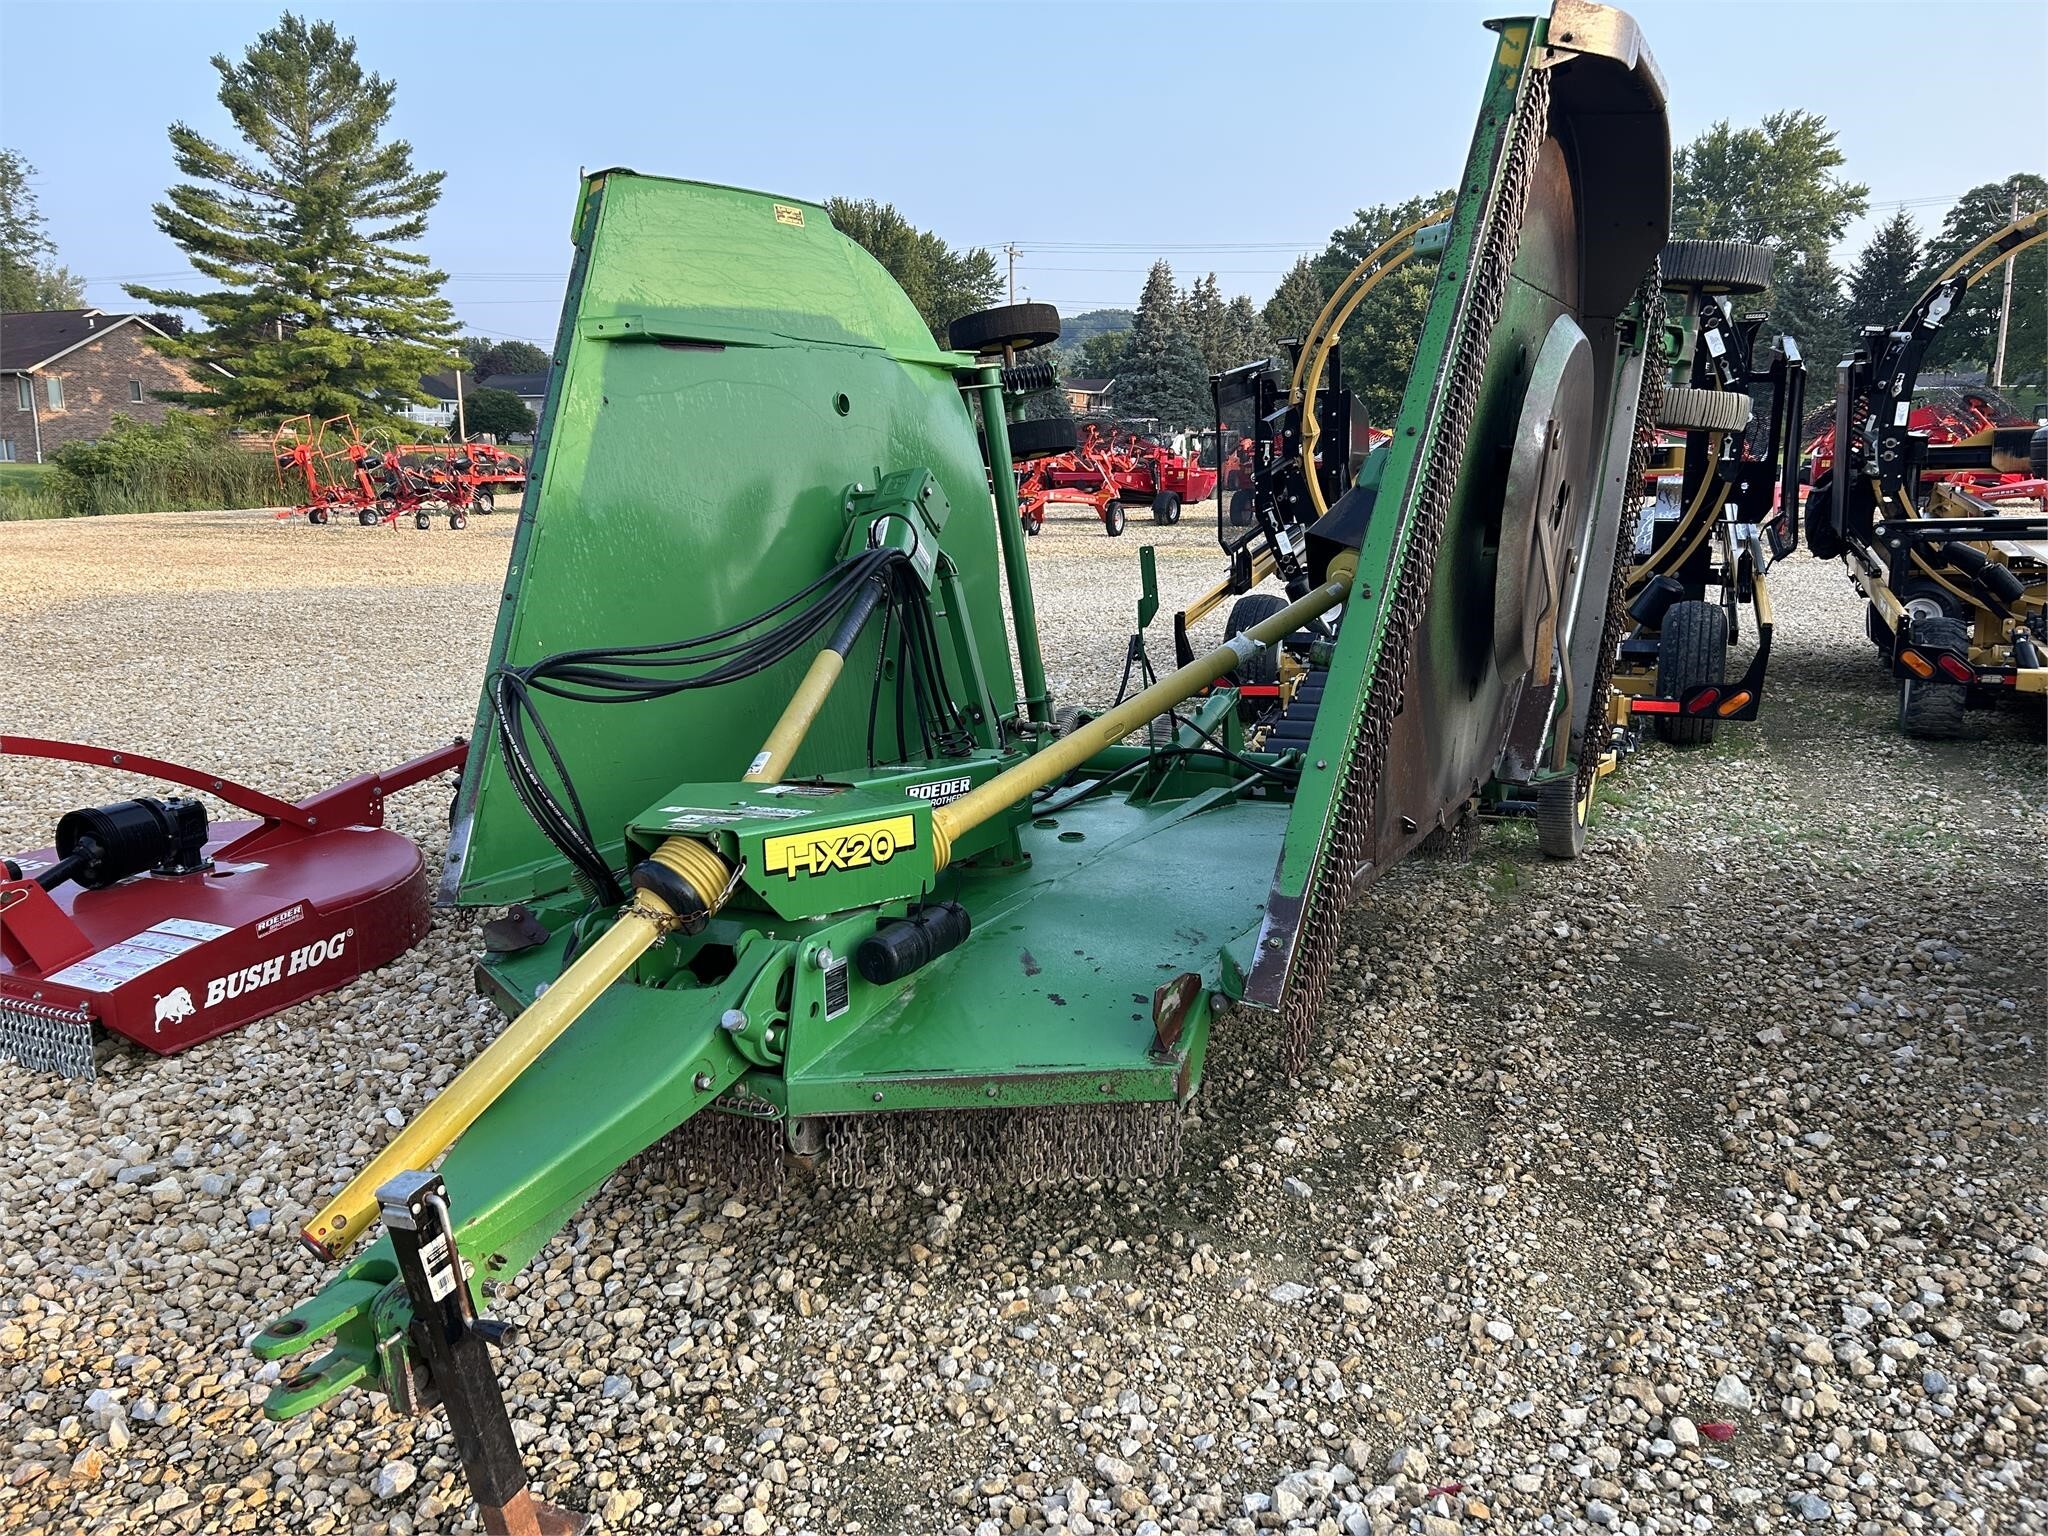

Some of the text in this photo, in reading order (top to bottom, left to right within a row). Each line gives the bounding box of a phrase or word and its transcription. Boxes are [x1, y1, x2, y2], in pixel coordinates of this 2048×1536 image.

[909, 779, 971, 800] ROEDER
[786, 829, 896, 879] HX20
[258, 906, 301, 931] ROEDER
[204, 955, 285, 1009] BUSH
[287, 931, 346, 976] HOG
